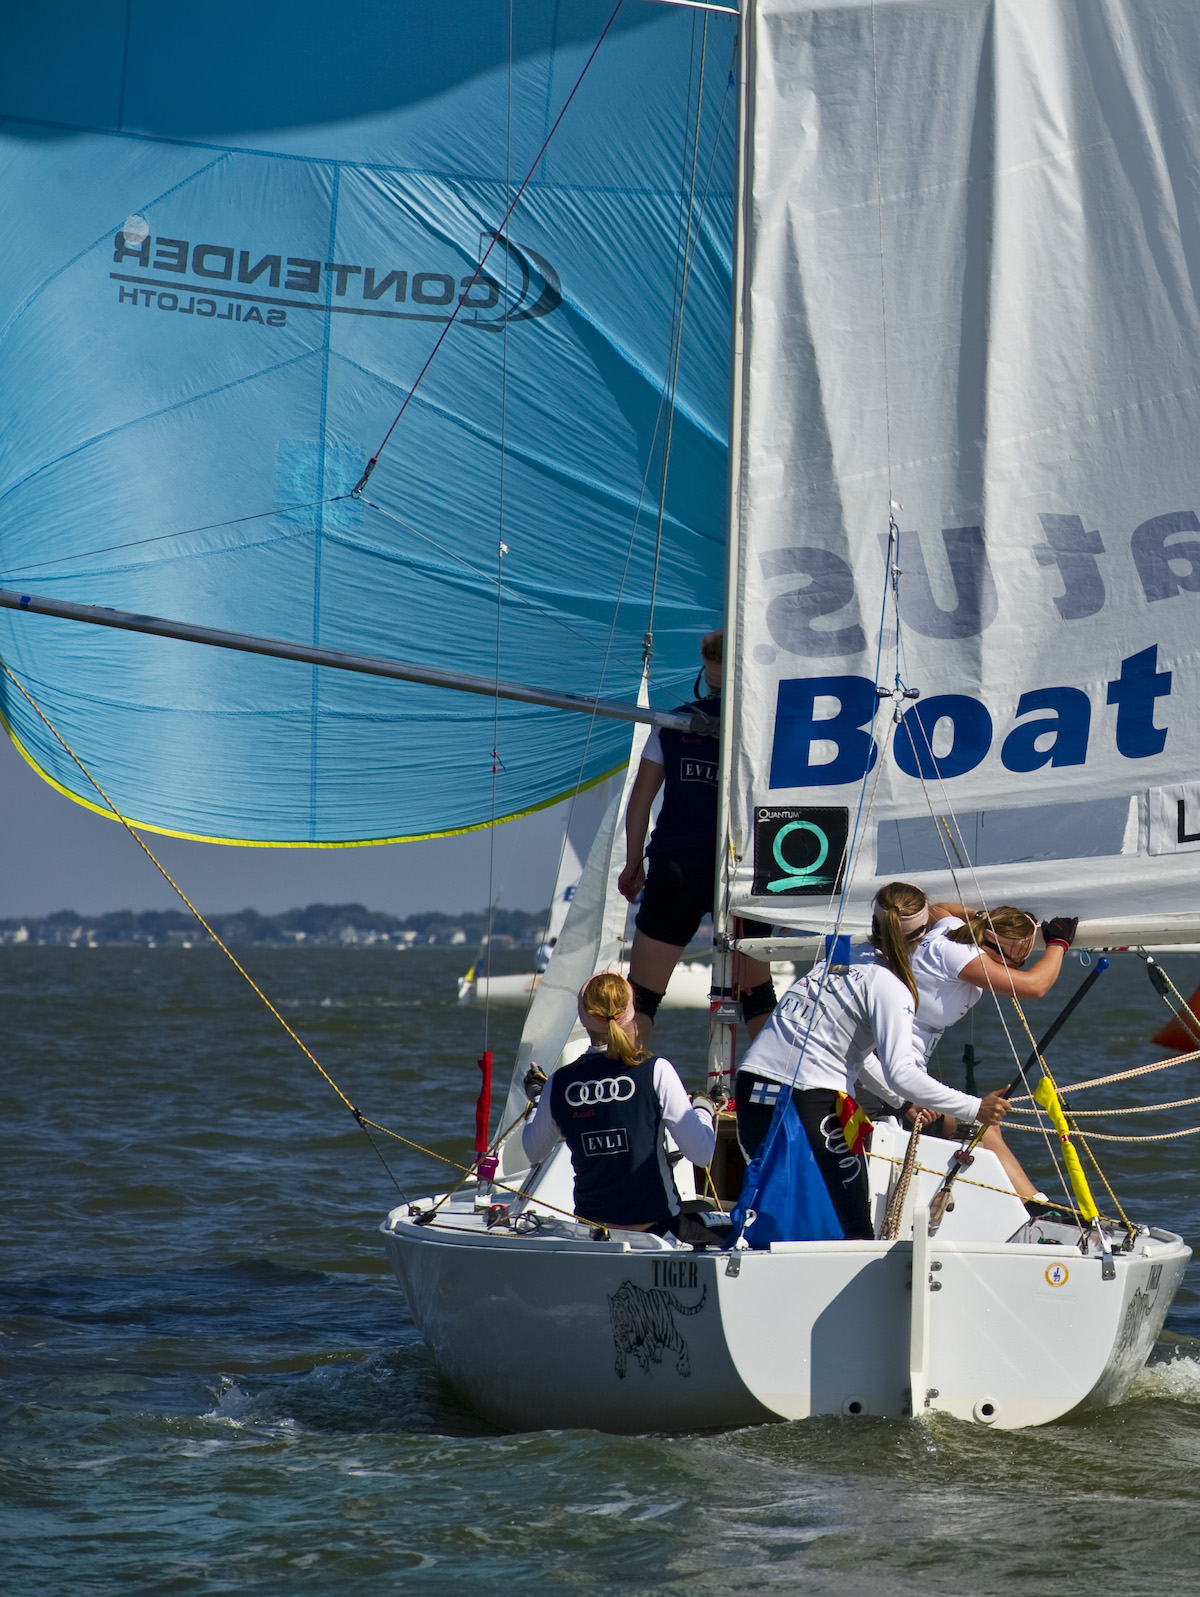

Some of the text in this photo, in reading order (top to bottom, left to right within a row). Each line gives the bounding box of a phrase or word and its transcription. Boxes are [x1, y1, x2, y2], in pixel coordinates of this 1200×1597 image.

[769, 643, 1172, 789] Boat
[758, 809, 800, 822] QUANTUM
[572, 1109, 595, 1118] Audi
[588, 1134, 622, 1150] EVLI
[652, 1260, 698, 1289] TIGER
